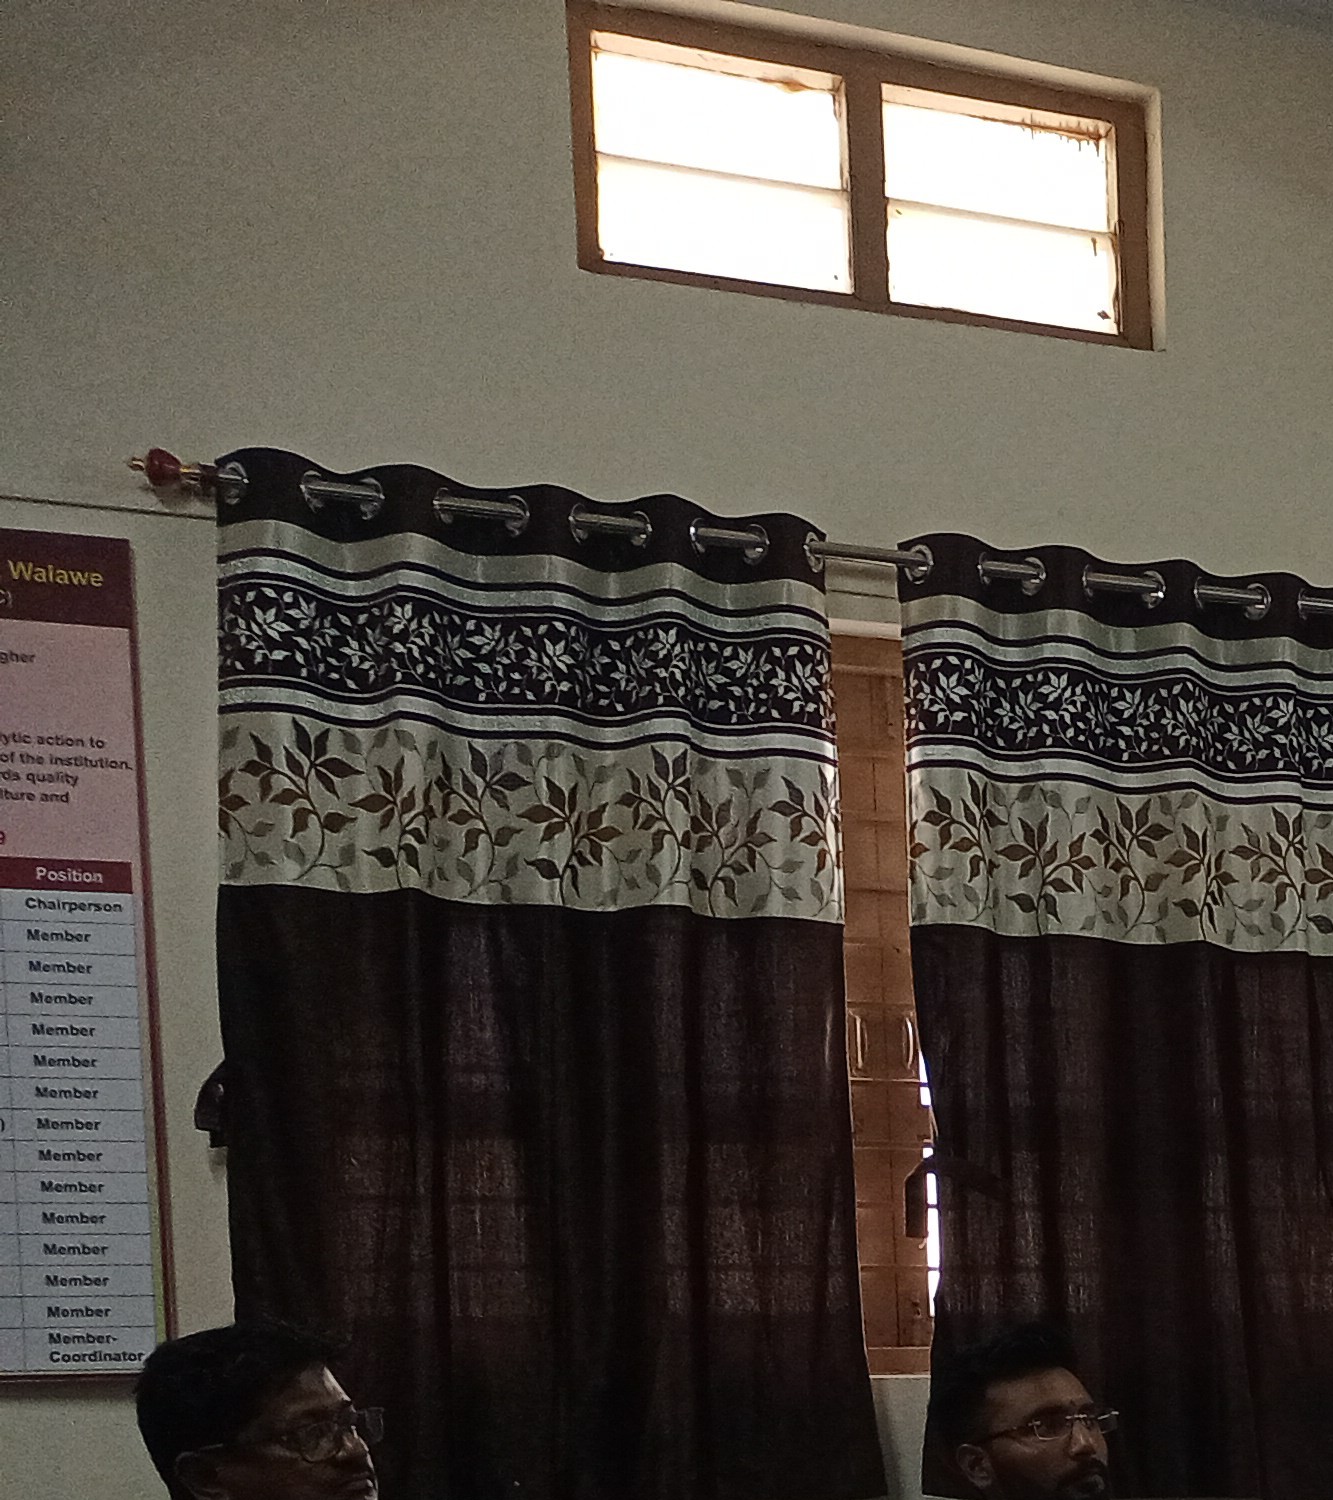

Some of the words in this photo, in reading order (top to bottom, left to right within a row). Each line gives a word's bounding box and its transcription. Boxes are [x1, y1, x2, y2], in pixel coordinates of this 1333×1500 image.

[7, 559, 105, 588] Walawe
[36, 734, 85, 748] action
[90, 736, 105, 749] to
[0, 752, 15, 763] of
[19, 752, 45, 765] the
[49, 753, 134, 771] institution.
[26, 771, 79, 788] quality
[40, 791, 70, 803] and
[35, 866, 104, 885] Position
[25, 897, 123, 915] Chairperson
[27, 928, 91, 943] Member
[29, 960, 92, 975] Member
[30, 991, 93, 1006] Member
[32, 1022, 95, 1037] Member
[33, 1054, 97, 1069] Member
[35, 1086, 99, 1100] Member
[37, 1117, 101, 1131] Member
[38, 1148, 102, 1163] Member
[40, 1180, 104, 1194] Member
[42, 1211, 106, 1225] Member
[43, 1242, 108, 1256] Member
[45, 1274, 109, 1288] Member
[47, 1305, 111, 1319] Member
[48, 1332, 118, 1346] Member-
[49, 1349, 144, 1364] Coordinator
